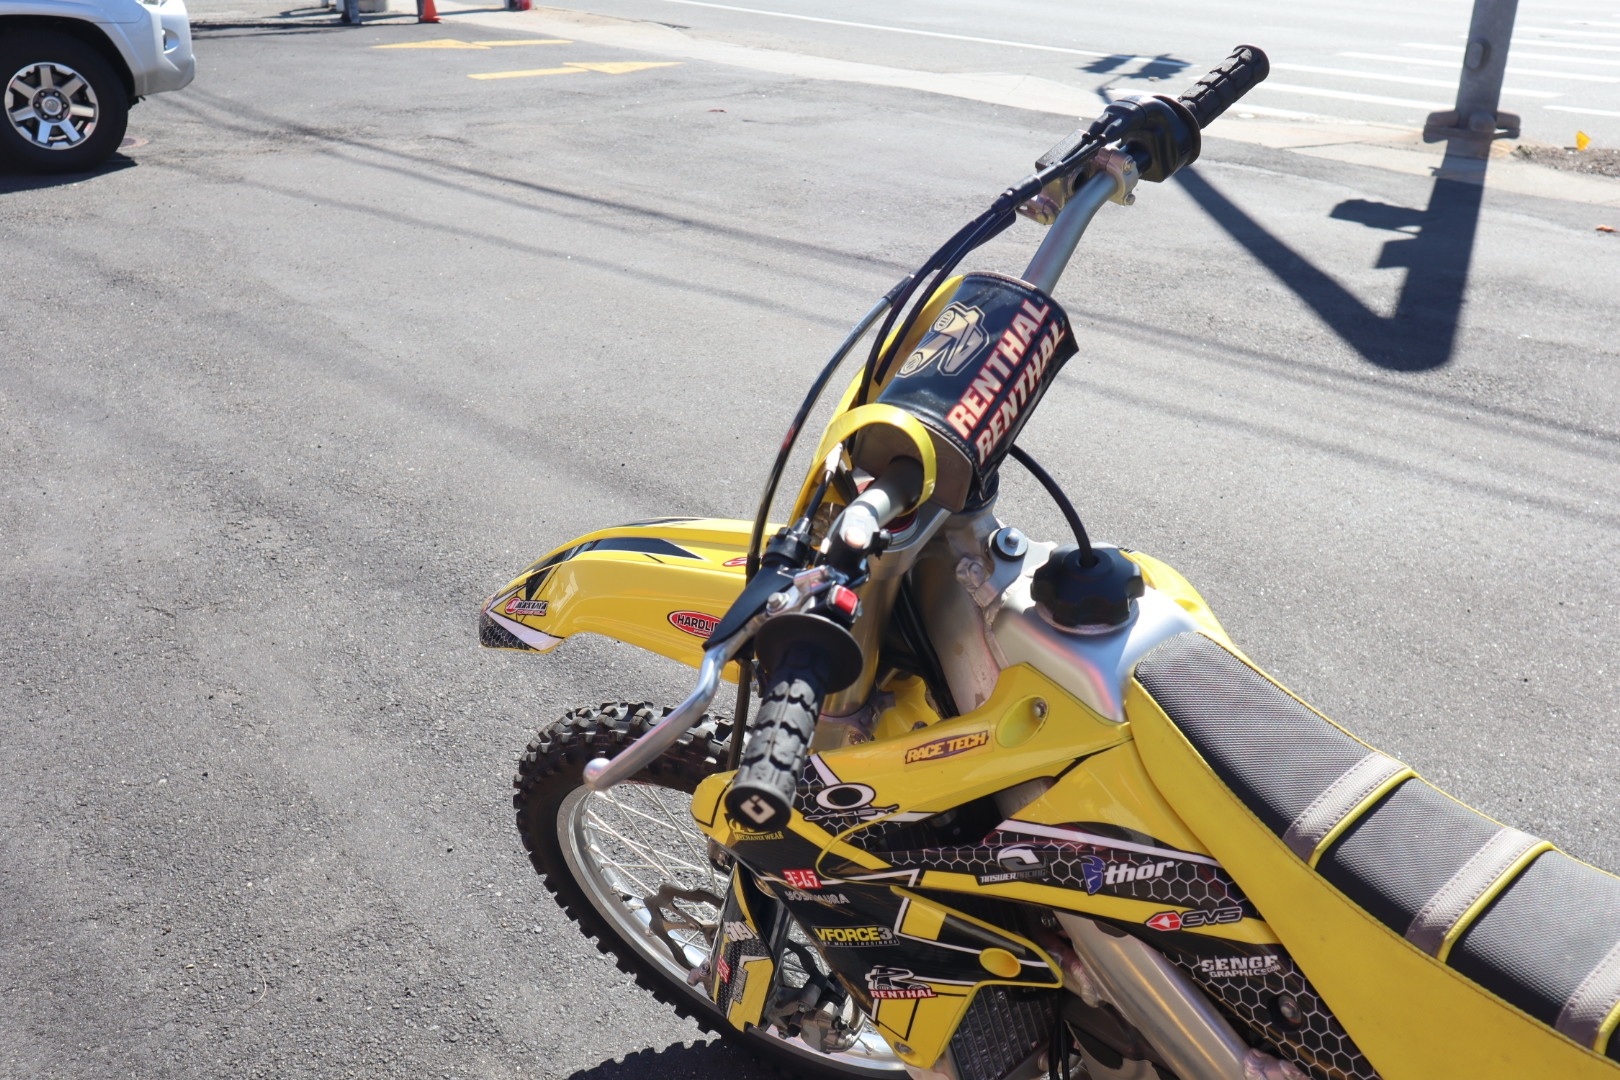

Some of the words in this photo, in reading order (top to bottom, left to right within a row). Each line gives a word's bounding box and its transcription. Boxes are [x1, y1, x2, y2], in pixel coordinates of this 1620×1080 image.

[946, 299, 1050, 439] RENTHAL
[975, 320, 1066, 465] RENTHAL
[677, 615, 719, 631] HARDLI
[906, 742, 945, 763] RACE
[946, 732, 987, 752] TECH
[765, 831, 784, 840] WEAR
[981, 872, 1017, 883] ANSWER
[1104, 861, 1174, 884] thor
[1208, 969, 1267, 977] GRAPHICS
[870, 988, 937, 998] RENTHAL
